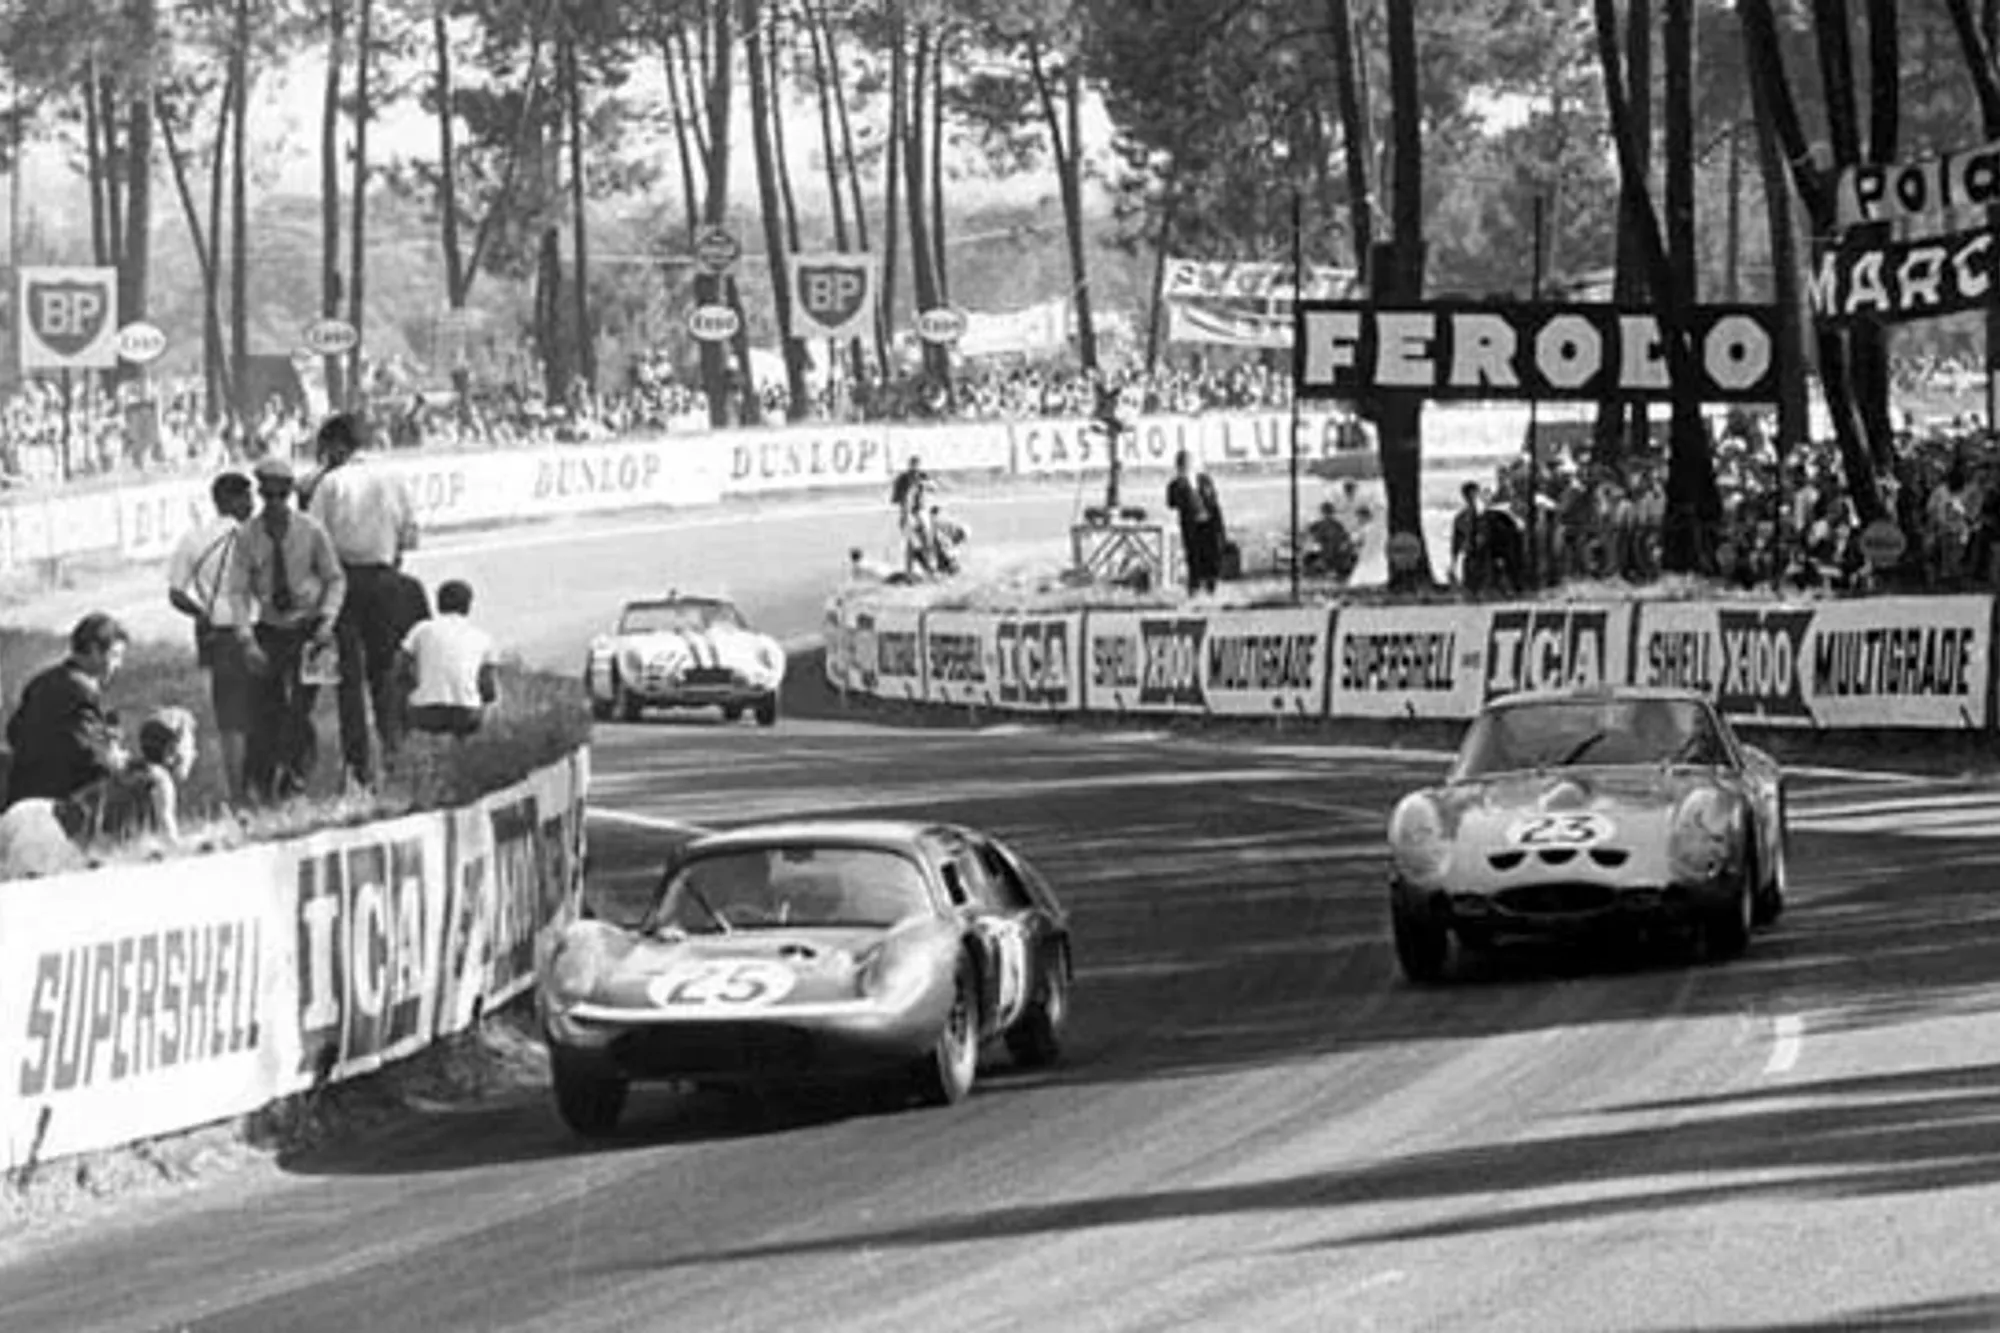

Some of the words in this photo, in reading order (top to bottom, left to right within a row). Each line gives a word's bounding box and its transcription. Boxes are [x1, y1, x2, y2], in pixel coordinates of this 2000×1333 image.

[809, 272, 861, 311] BP
[1806, 235, 1992, 315] MARC
[40, 290, 99, 335] BP
[1304, 311, 1772, 390] FERODO
[534, 453, 662, 499] DUNLOP
[730, 440, 878, 480] DUNLOP
[1000, 636, 1066, 688] ICA
[1490, 629, 1600, 691] ICA
[1812, 627, 1975, 696] MULTIGRADE
[1519, 814, 1598, 845] 23
[18, 917, 261, 1097] SUPERSHELL
[302, 875, 424, 1033] ICA
[667, 962, 767, 1005] 25
